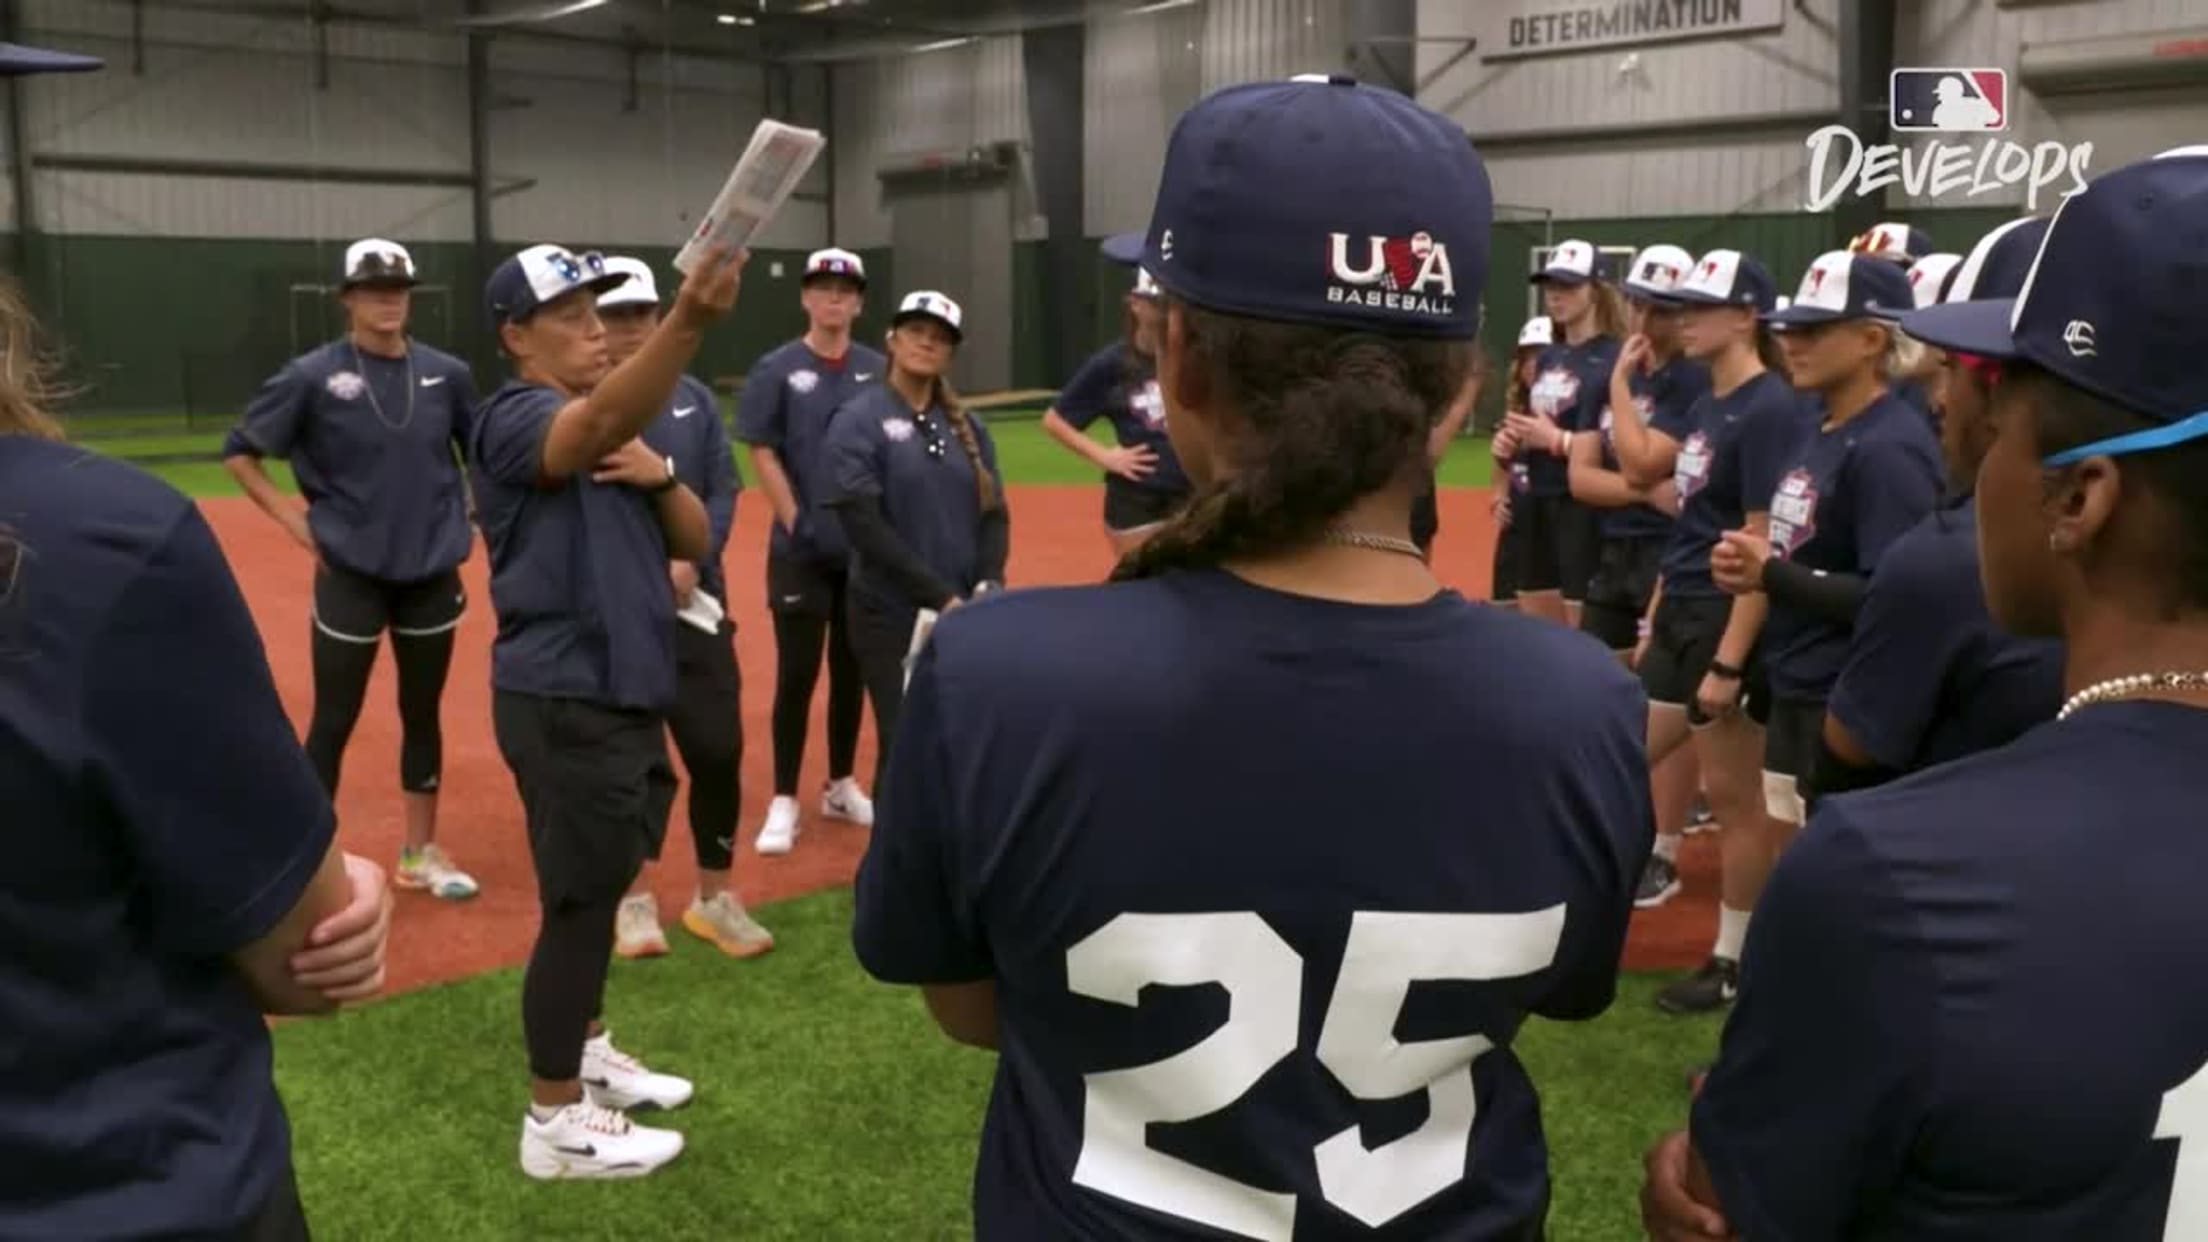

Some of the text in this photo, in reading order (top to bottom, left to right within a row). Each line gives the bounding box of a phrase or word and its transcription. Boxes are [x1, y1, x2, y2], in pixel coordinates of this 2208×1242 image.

[1508, 0, 1742, 47] DETERMINATION
[1326, 286, 1454, 315] BASEBALL
[1066, 901, 1567, 1242] 25
